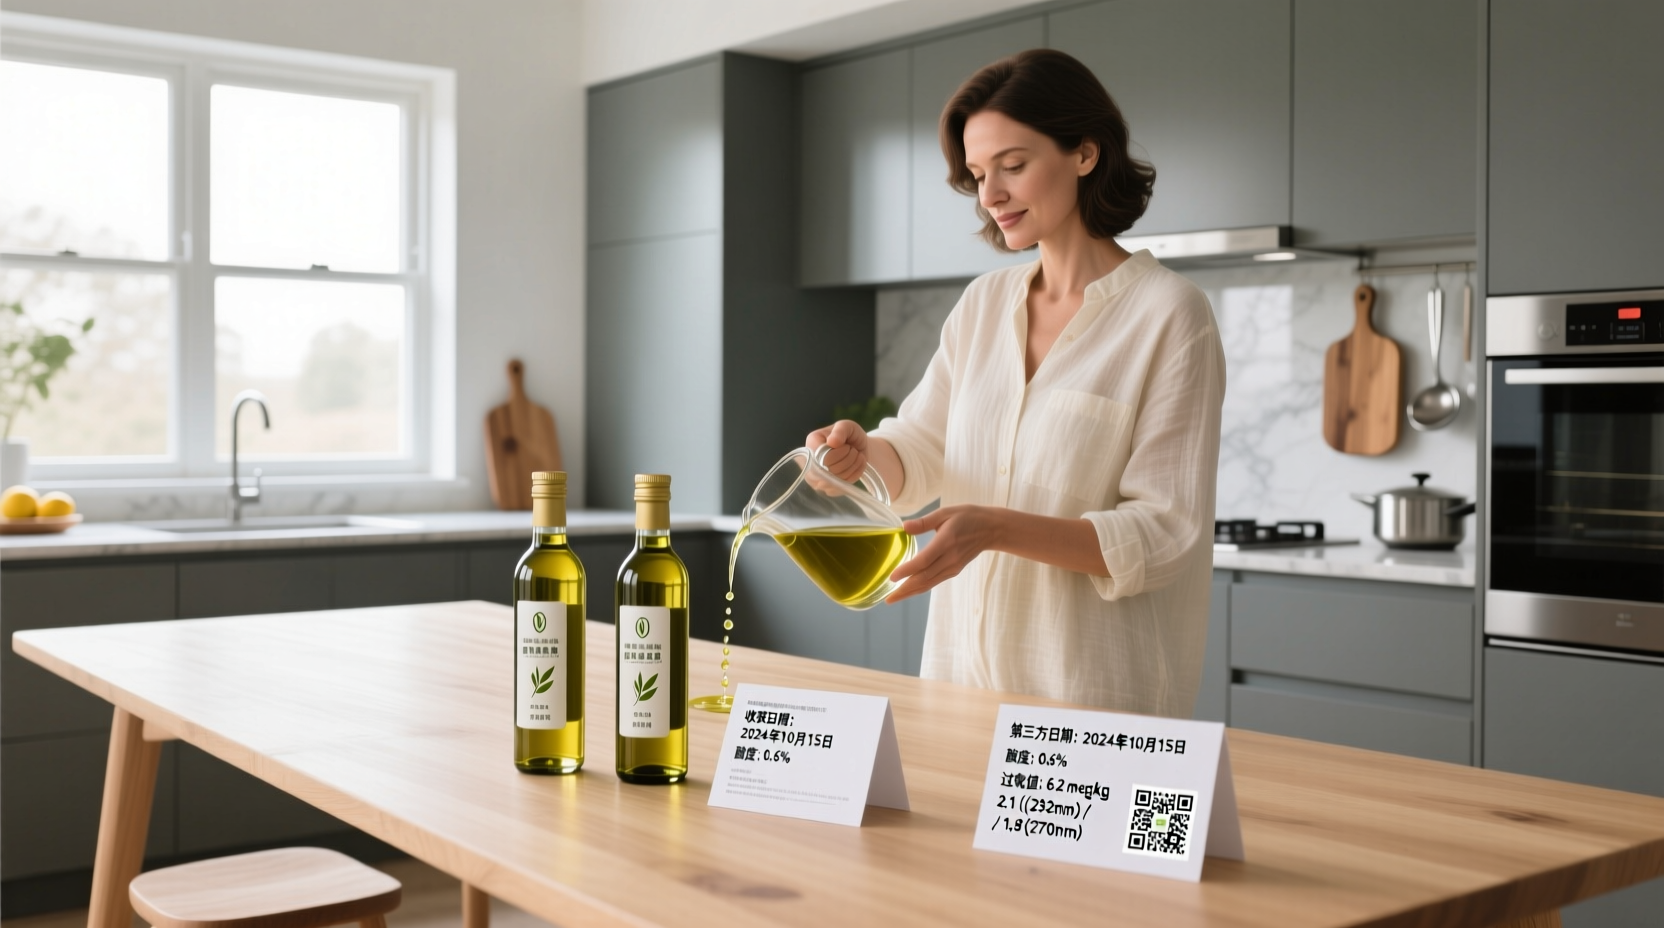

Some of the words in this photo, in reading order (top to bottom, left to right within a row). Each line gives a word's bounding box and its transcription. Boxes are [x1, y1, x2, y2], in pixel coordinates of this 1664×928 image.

[740, 727, 834, 750] 2024年10月15日
[1082, 731, 1187, 755] 2024年10月15日
[763, 748, 791, 764] 0.6%
